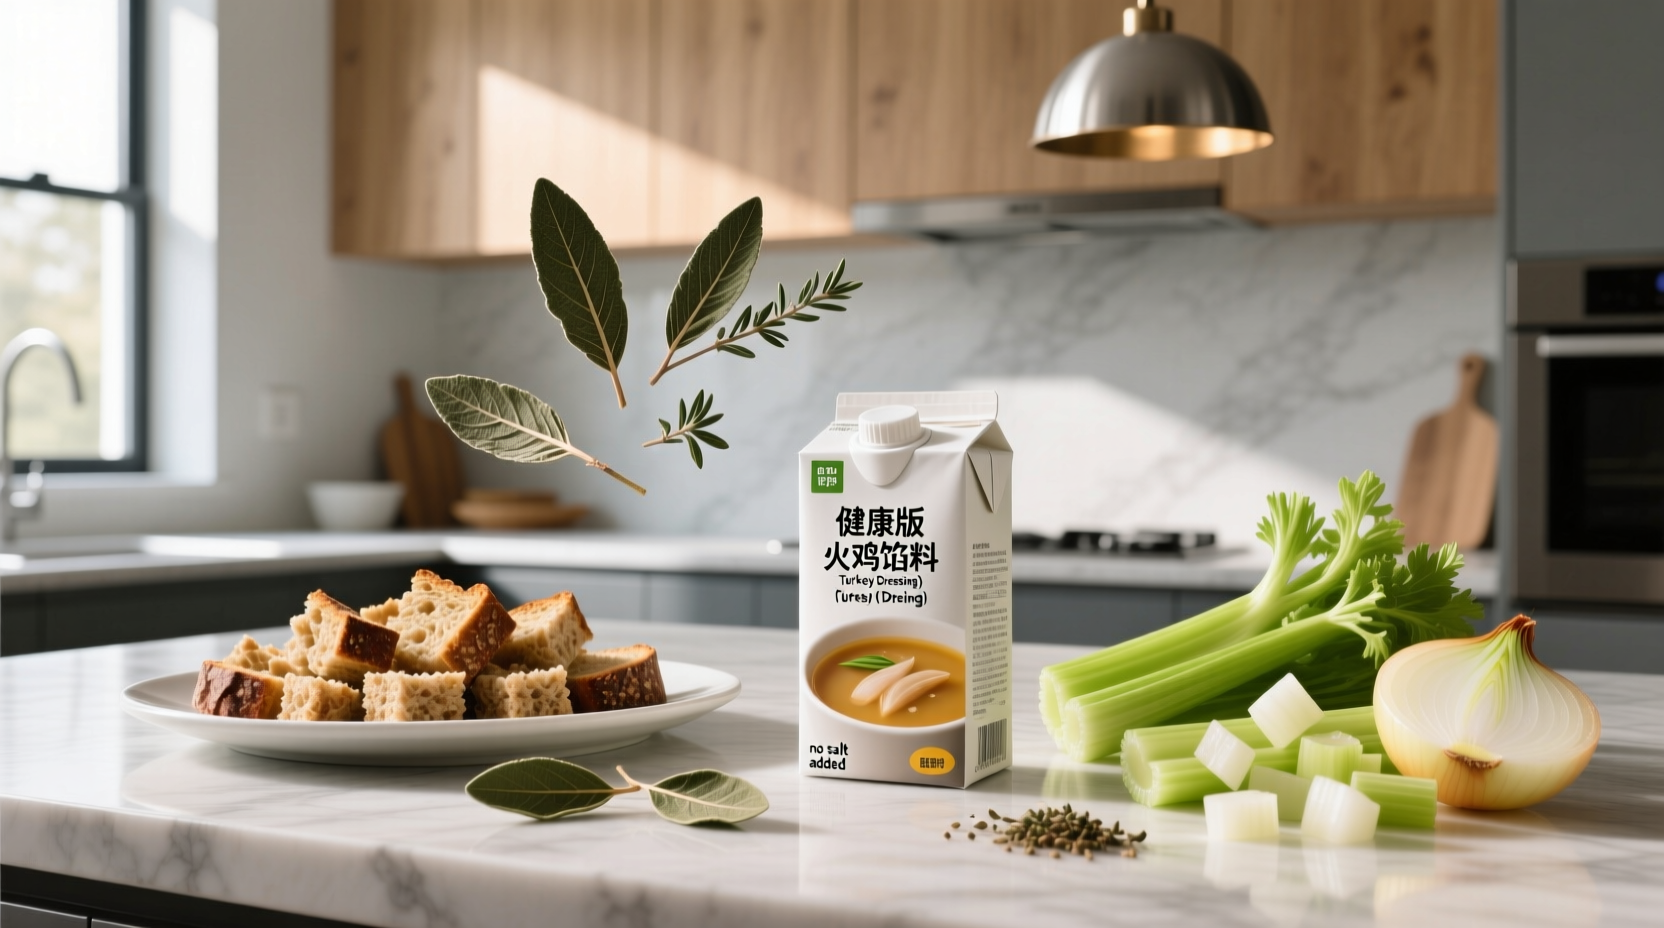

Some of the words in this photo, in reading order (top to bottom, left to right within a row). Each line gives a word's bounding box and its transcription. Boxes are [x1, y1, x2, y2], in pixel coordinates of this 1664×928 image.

[835, 505, 925, 538] 健康版
[824, 541, 939, 572] 火鸡馅料
[838, 574, 875, 588] Turkey
[809, 744, 824, 754] no
[827, 742, 849, 756] salt
[809, 756, 846, 770] added
